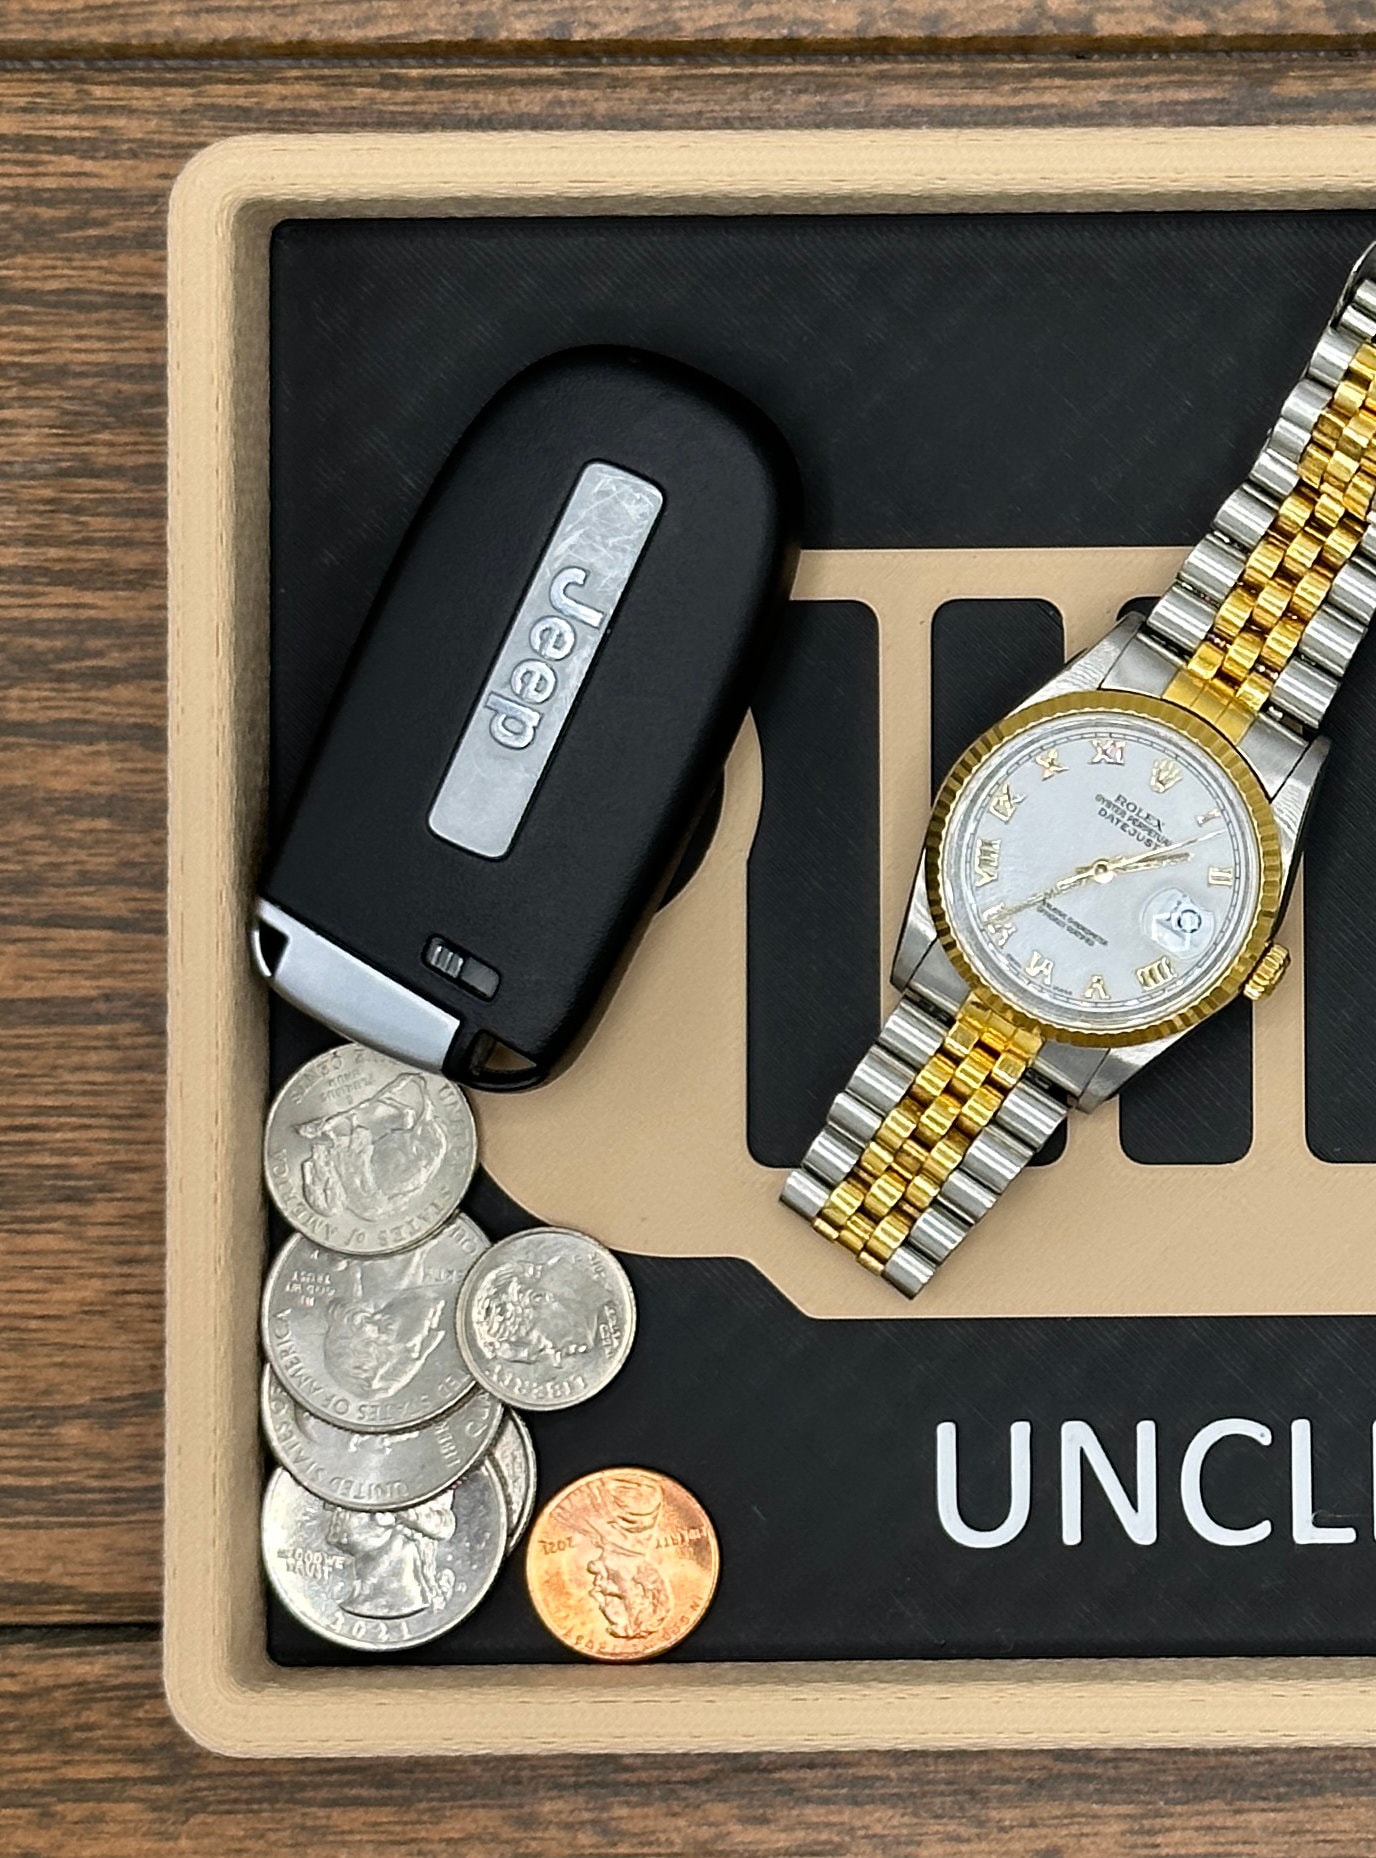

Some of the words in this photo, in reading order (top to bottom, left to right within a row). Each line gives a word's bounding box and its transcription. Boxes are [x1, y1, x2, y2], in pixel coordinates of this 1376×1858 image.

[484, 566, 604, 750] Jeep
[1095, 794, 1127, 818] OYSTER
[1114, 794, 1165, 833] ROLEX
[1098, 808, 1161, 850] DATEJUST
[271, 1148, 338, 1241] AMERICA
[272, 1307, 325, 1396] AMERICA
[326, 1397, 349, 1415] OF
[275, 1421, 326, 1480] STATES
[330, 1476, 409, 1499] UNITED
[537, 1535, 575, 1556] 2021
[327, 1611, 411, 1641] 2021
